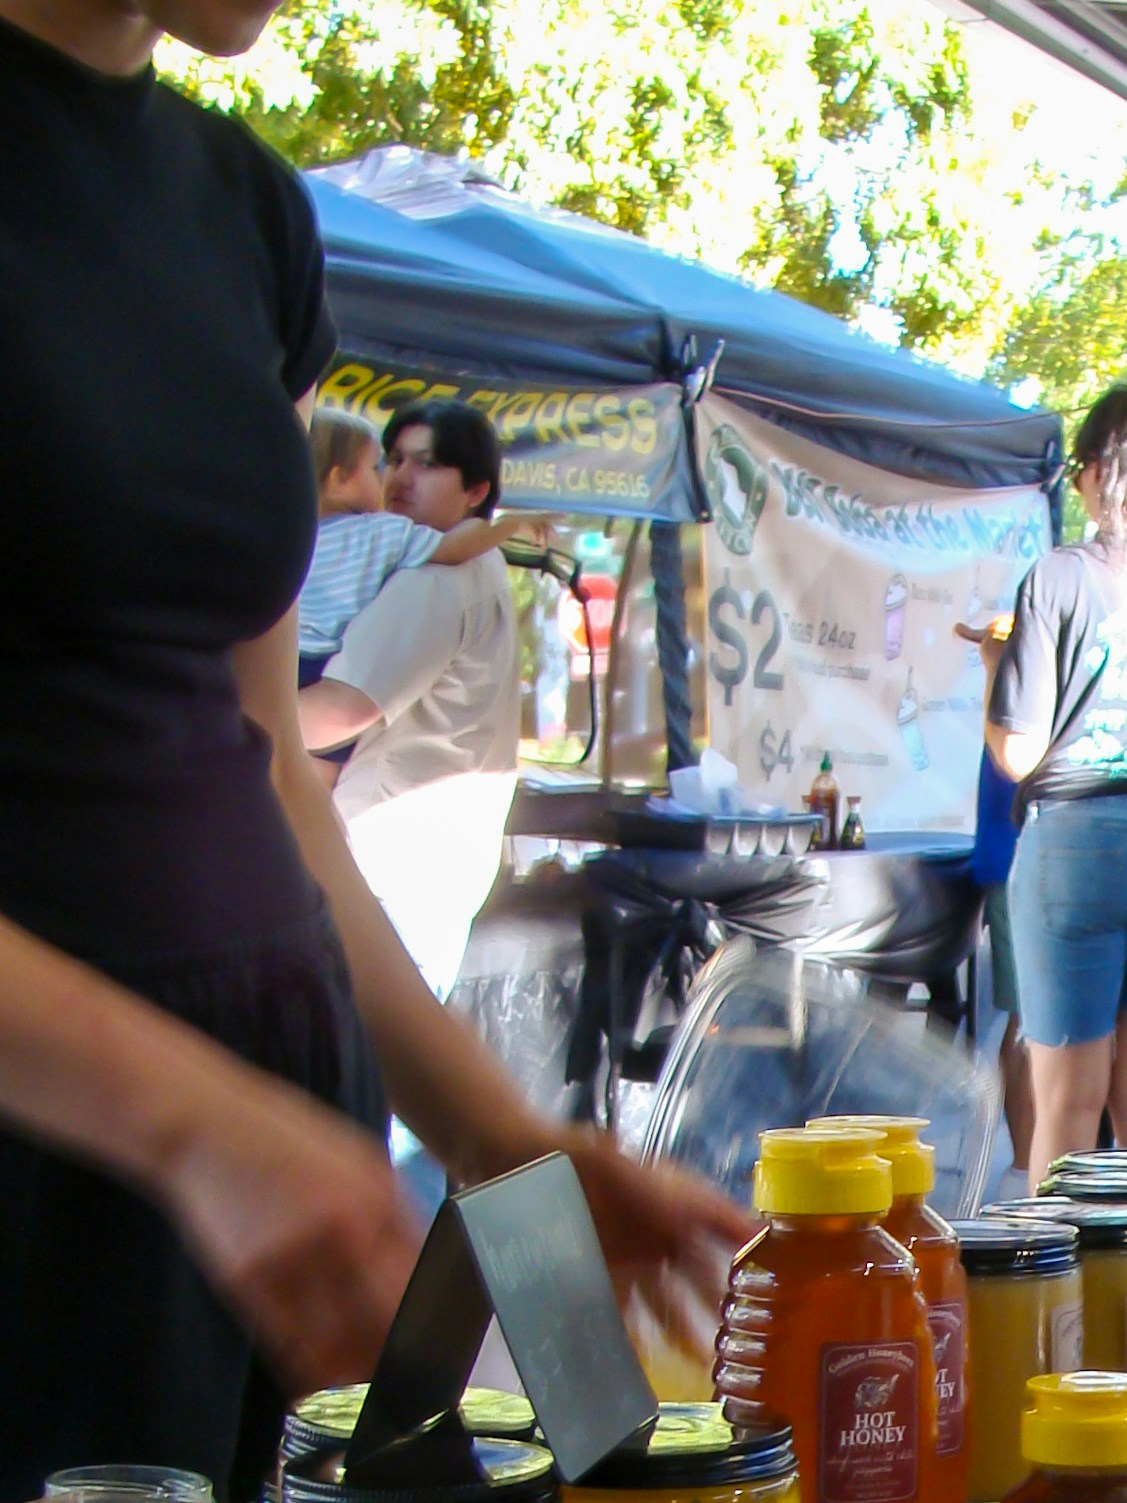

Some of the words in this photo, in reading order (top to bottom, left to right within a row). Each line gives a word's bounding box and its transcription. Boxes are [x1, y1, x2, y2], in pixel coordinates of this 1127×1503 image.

[501, 457, 562, 495] DAVIS,
[566, 466, 592, 492] CA
[594, 466, 651, 499] 95616
[708, 567, 784, 707] $2
[759, 719, 795, 782] $4
[840, 1425, 906, 1446] HONEY
[855, 1411, 896, 1430] HOT
